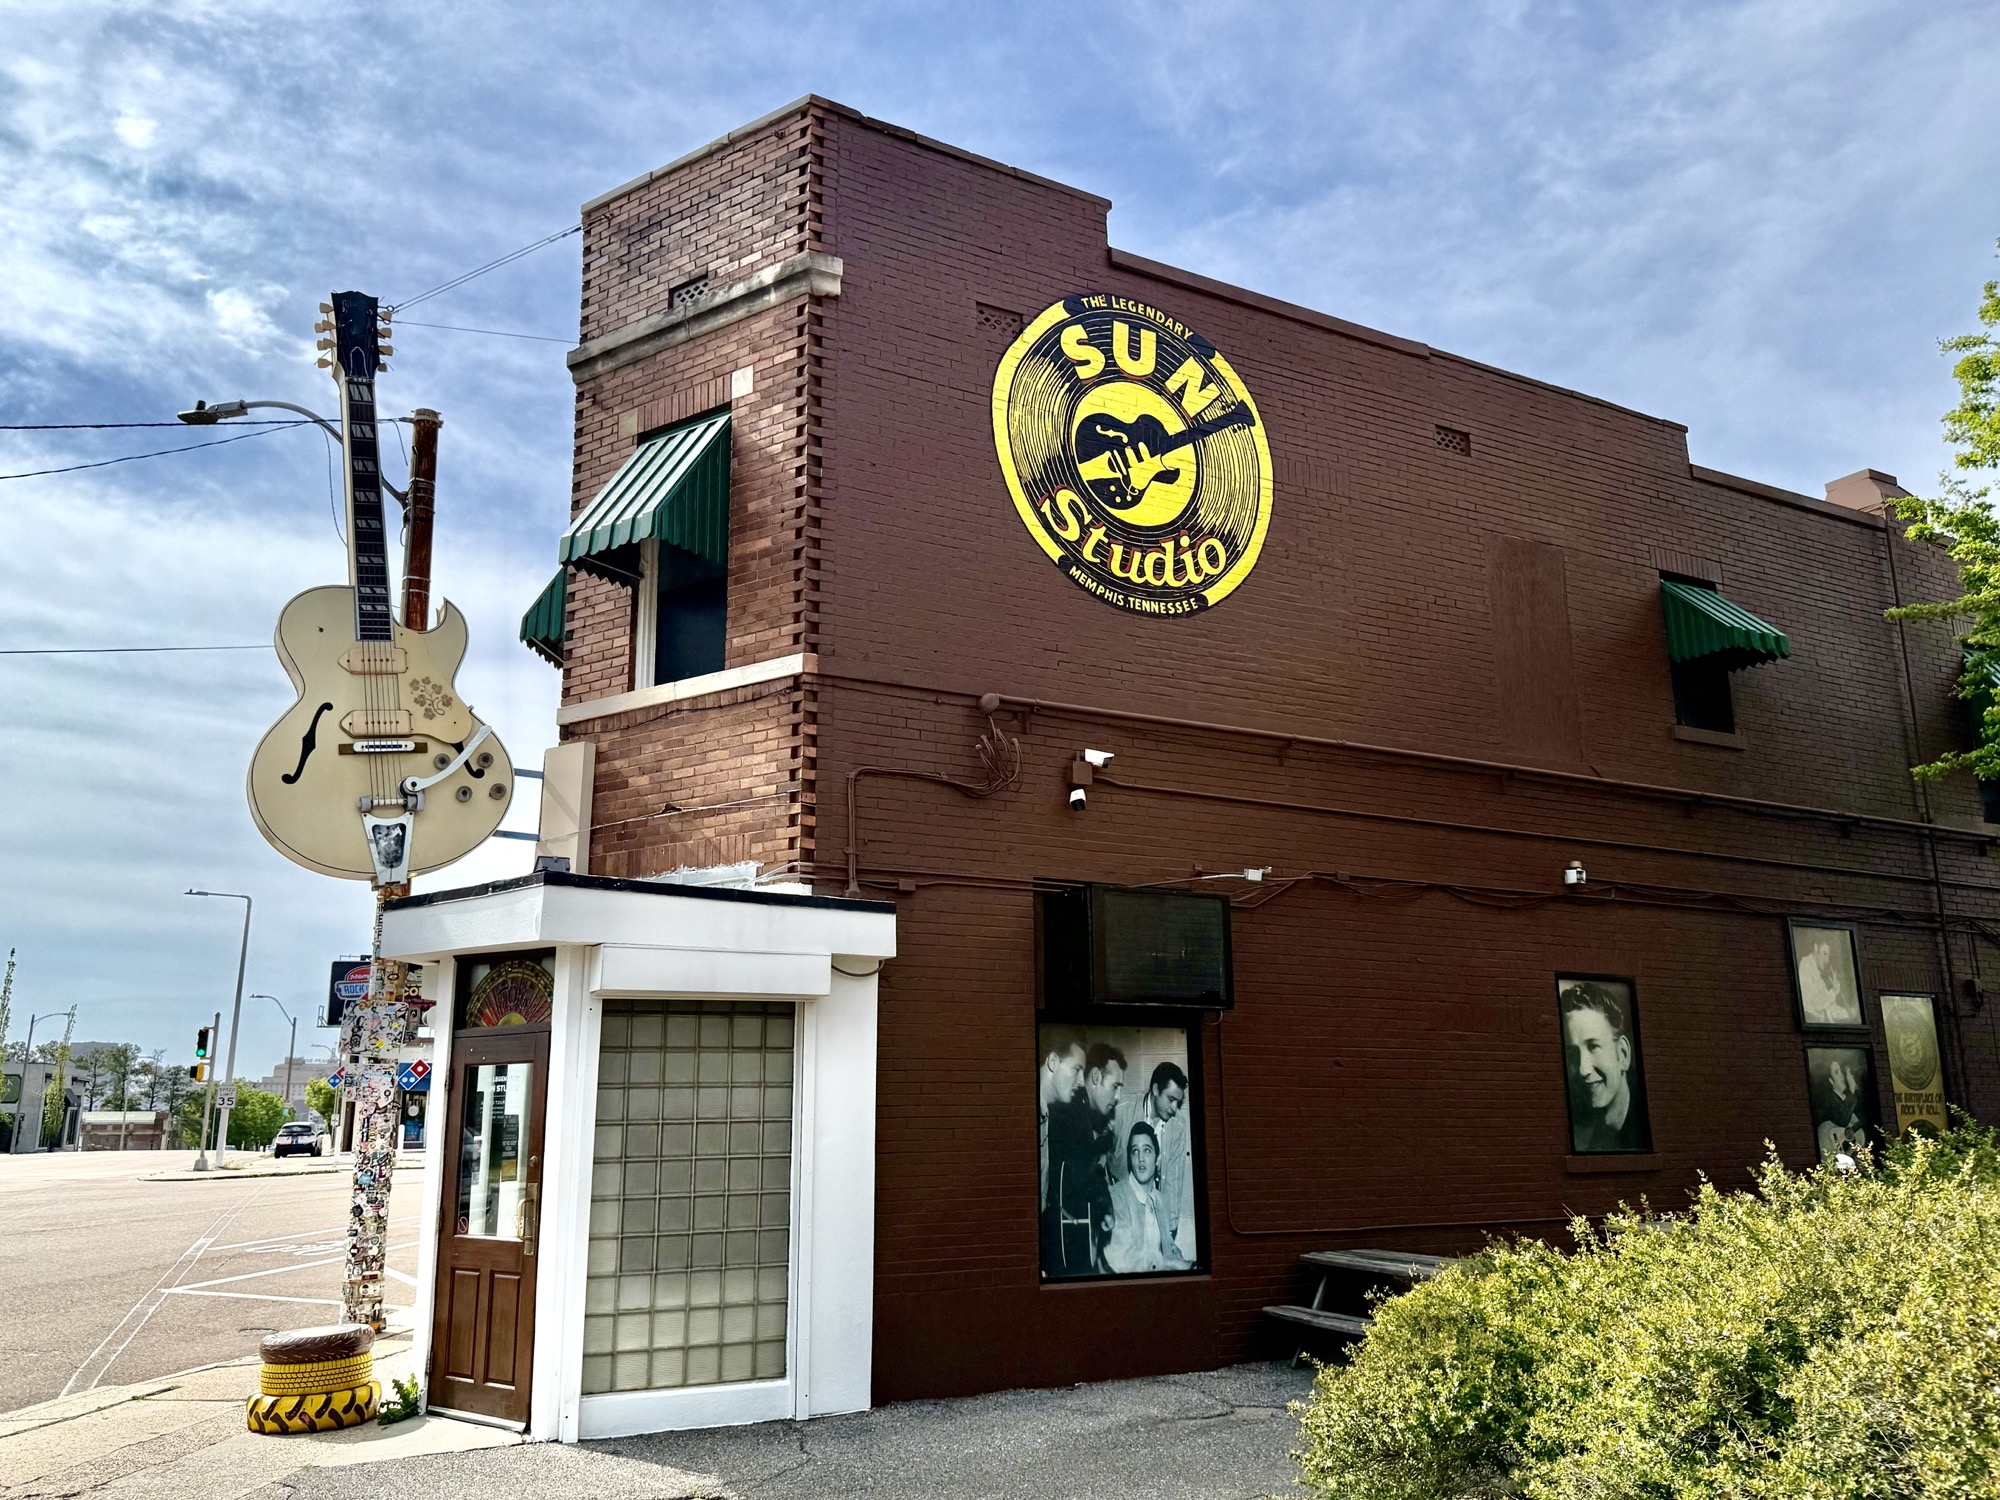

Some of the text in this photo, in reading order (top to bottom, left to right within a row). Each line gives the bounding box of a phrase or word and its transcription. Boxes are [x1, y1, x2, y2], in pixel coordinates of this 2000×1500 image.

[1081, 294, 1194, 340] THE LEGENDARY
[1060, 321, 1220, 421] SUN
[1038, 486, 1227, 588] Studio
[1128, 597, 1199, 614] TENNESSEE
[343, 984, 365, 995] ROCK
[218, 1096, 235, 1106] 35
[1901, 1103, 1916, 1116] ROCK
